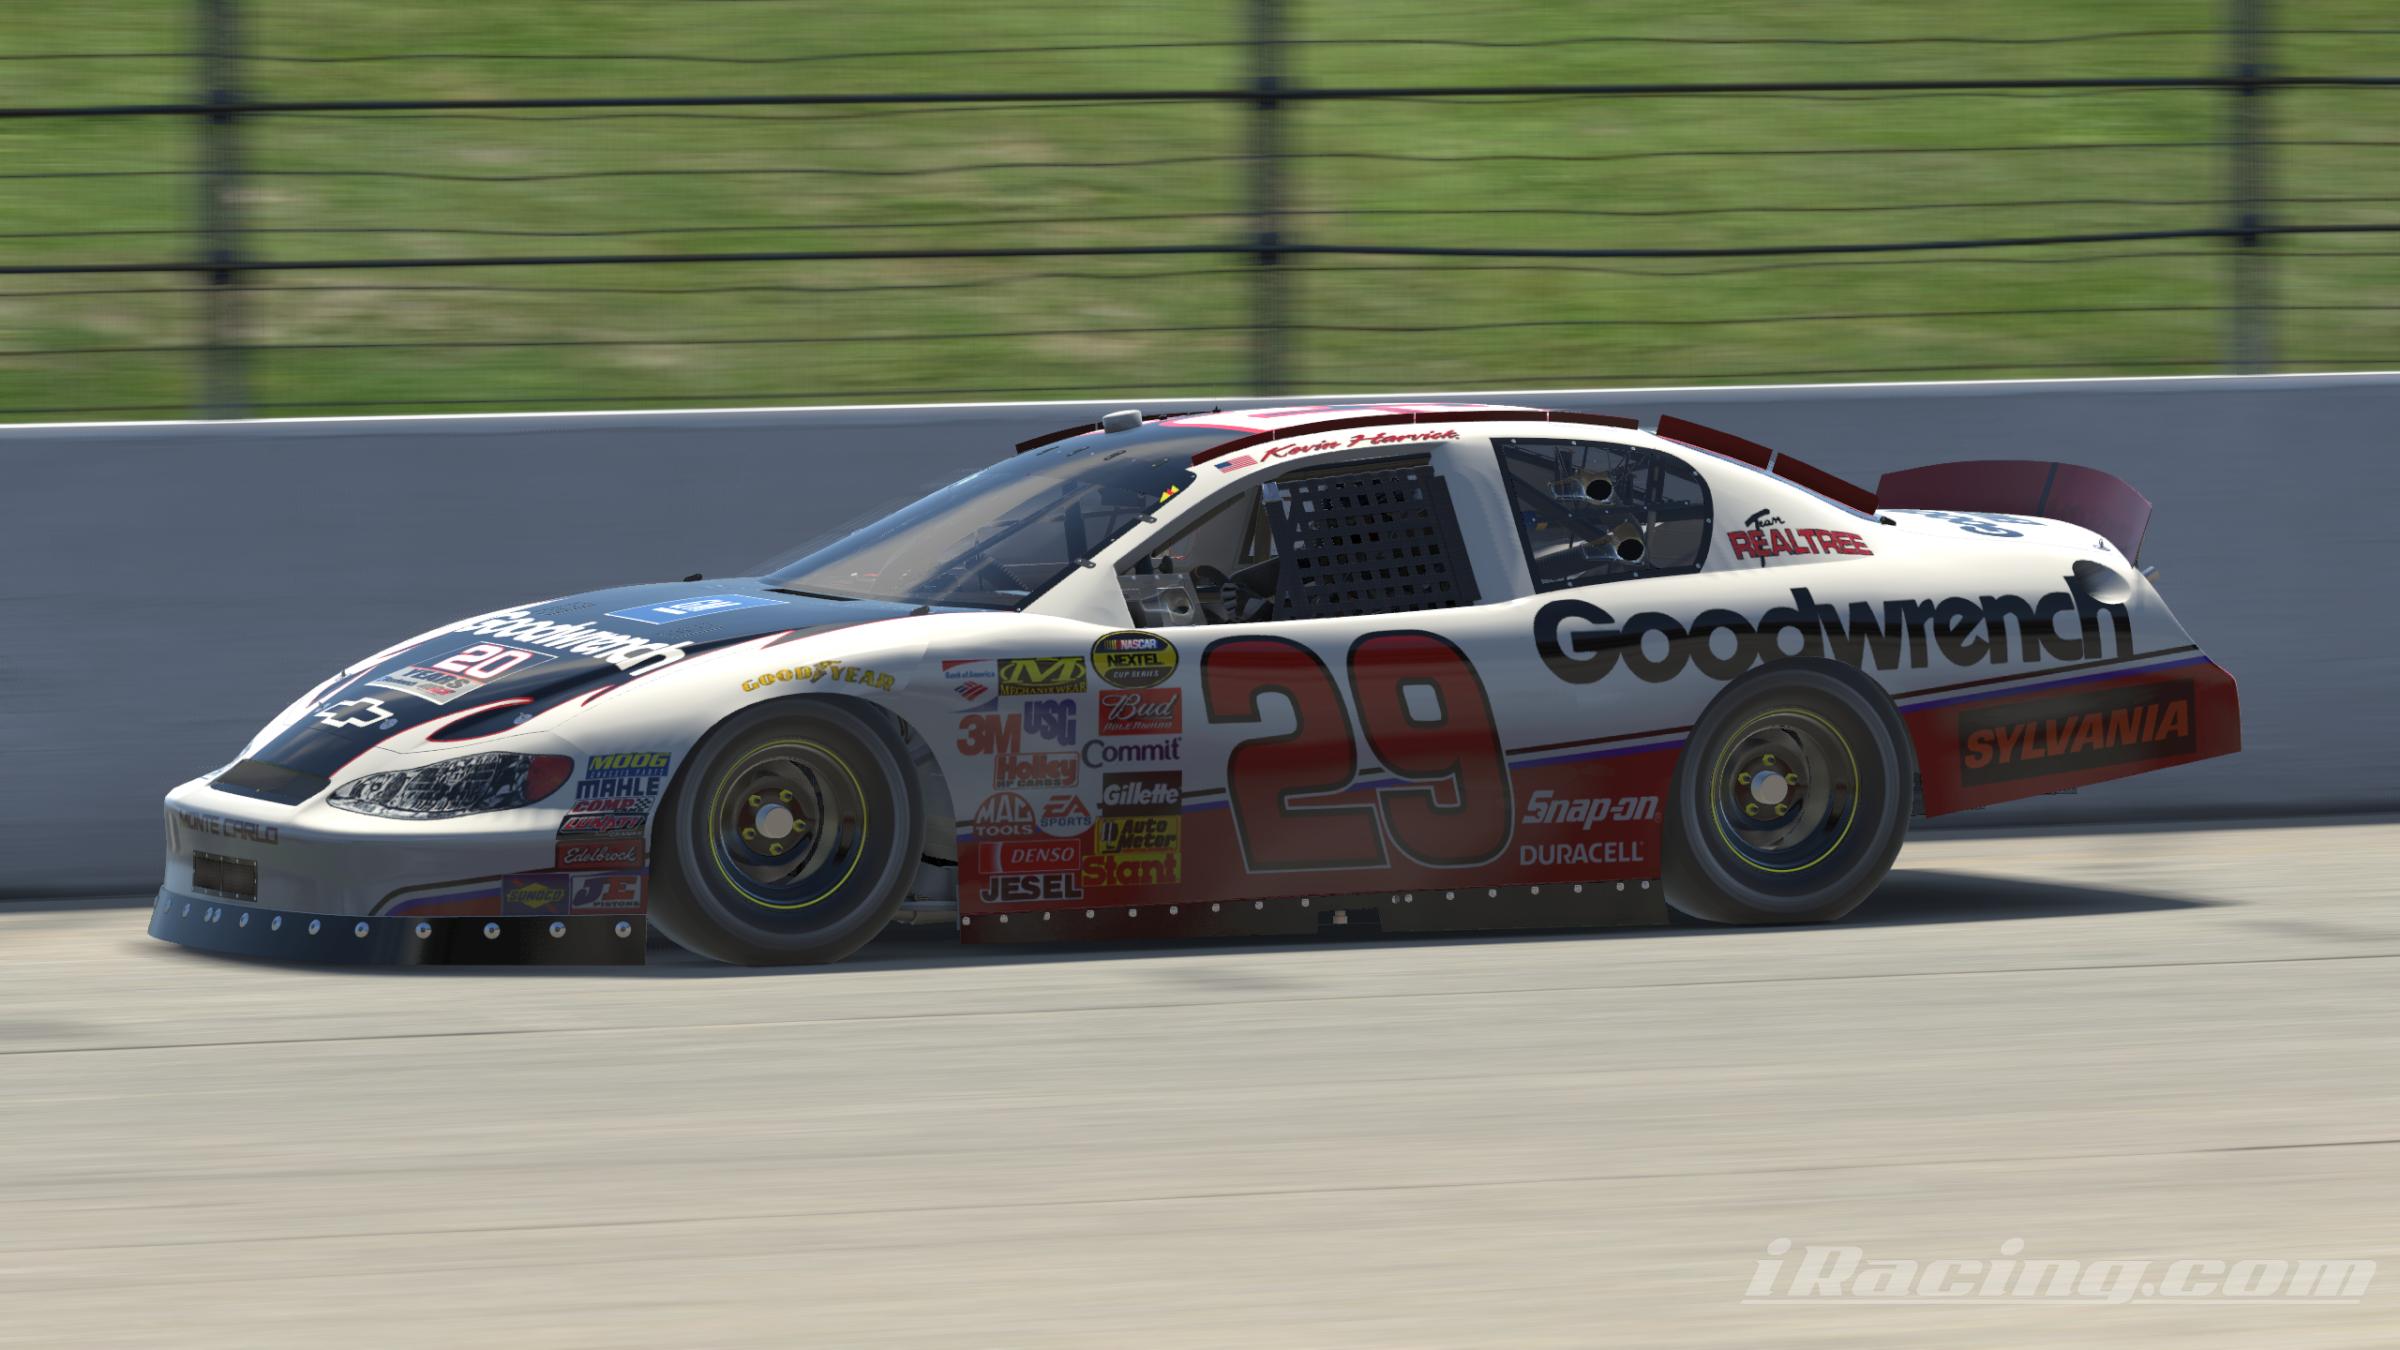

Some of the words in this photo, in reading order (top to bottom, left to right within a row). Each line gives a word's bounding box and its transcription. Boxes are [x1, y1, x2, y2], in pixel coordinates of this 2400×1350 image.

[1727, 528, 1875, 560] REALTREE
[1533, 575, 2133, 685] Goodwrench
[1120, 639, 1157, 650] NASCAR
[432, 643, 534, 679] 20
[1107, 653, 1165, 667] NEXTEL
[402, 668, 470, 689] YEARS
[741, 660, 896, 692] GOODYEAR
[1132, 670, 1159, 678] SERIES
[1102, 693, 1179, 721] Bud
[956, 713, 1022, 756] 3M
[1024, 699, 1077, 747] USG
[1964, 700, 2189, 769] SYLVANIA
[589, 752, 669, 770] MOOG
[1082, 738, 1180, 768] Commit
[1200, 629, 1516, 874] 29
[996, 752, 1077, 786] Holley
[576, 777, 660, 799] MAHLE
[1103, 782, 1179, 806] Gillette
[571, 799, 636, 813] COMP
[976, 793, 1033, 822] MAC
[1041, 794, 1090, 817] EA
[1522, 790, 1659, 831] Snap-on
[178, 809, 220, 835] MONTE
[223, 818, 279, 845] CARLO
[976, 824, 1033, 837] TOOLS
[1040, 816, 1092, 828] SPORTS
[1123, 818, 1168, 833] Auto
[1118, 833, 1176, 849] Meter
[1520, 842, 1644, 865] DURACELL
[564, 847, 637, 863] Edelbrock
[1010, 847, 1075, 864] DENSO
[1083, 853, 1178, 885] Stant
[507, 888, 565, 902] SUNOCO
[573, 876, 638, 906] JE
[979, 873, 1084, 904] JESEL
